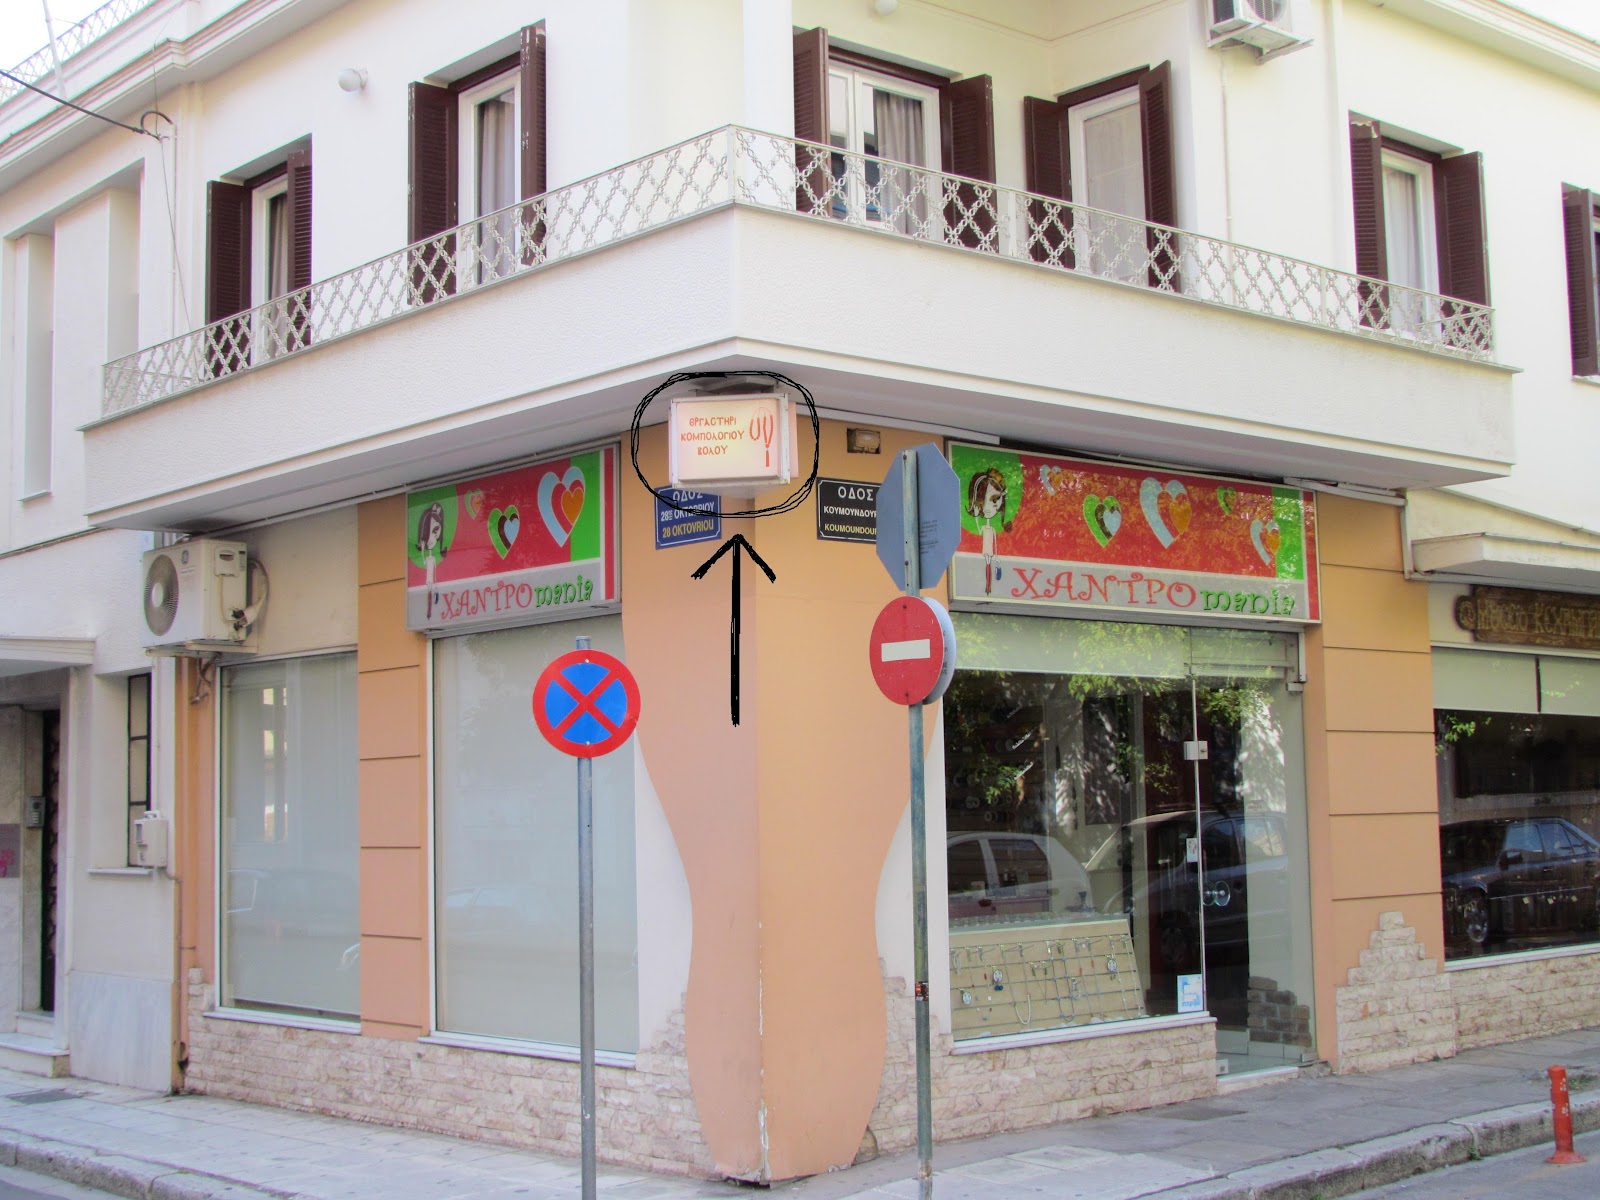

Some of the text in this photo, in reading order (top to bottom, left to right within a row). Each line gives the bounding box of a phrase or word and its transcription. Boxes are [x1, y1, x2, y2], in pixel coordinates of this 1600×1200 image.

[680, 430, 745, 441] ΚΟΜΠΟΛΟΓΙΟΥ
[697, 445, 728, 456] ΒΟΛΟΥ
[838, 486, 874, 502] ΟΔΟΣ
[662, 518, 714, 539] 28 OKTOVRIOU
[824, 523, 877, 536] KOUMOUNDOU
